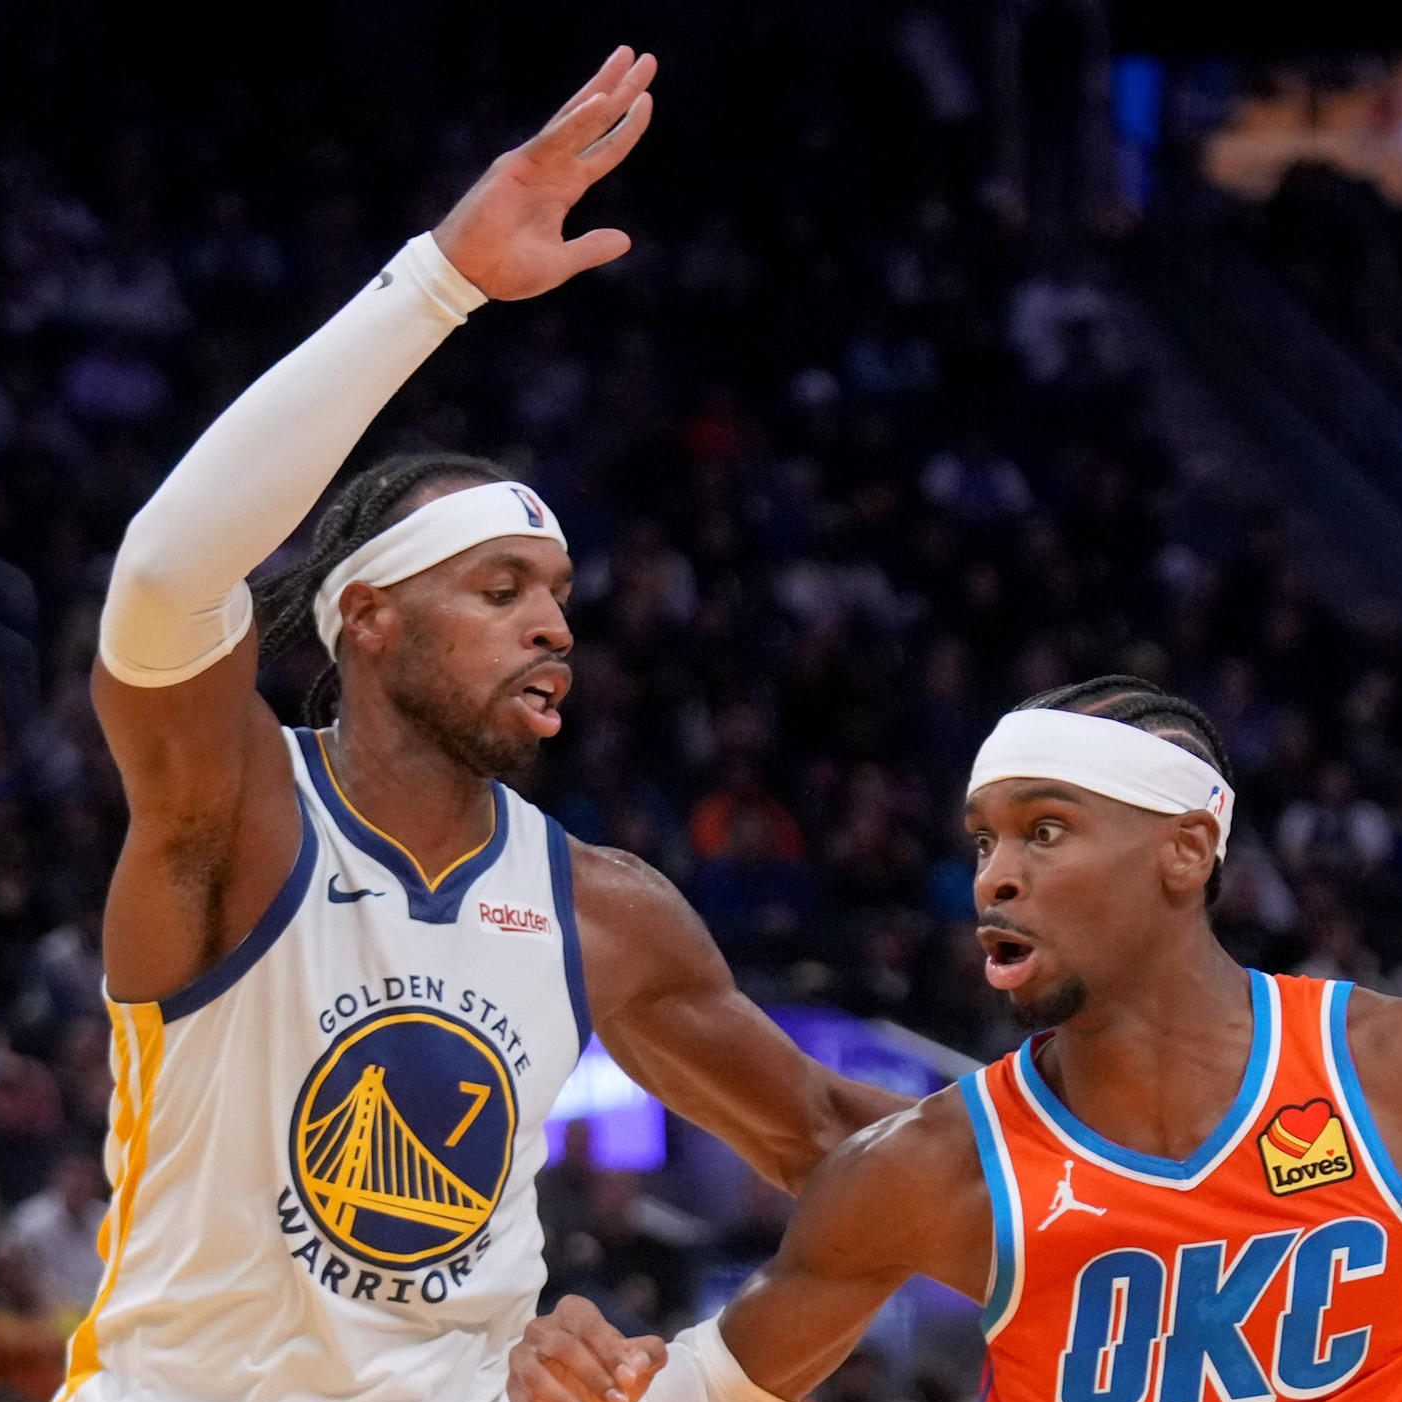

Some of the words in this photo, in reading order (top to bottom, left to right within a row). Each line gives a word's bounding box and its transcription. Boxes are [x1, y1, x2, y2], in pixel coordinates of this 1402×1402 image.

[479, 902, 551, 934] Rakuten
[318, 975, 446, 1034] GOLDEN
[459, 989, 531, 1076] STATE
[444, 1080, 492, 1147] 7
[277, 1185, 492, 1304] WARRIORS
